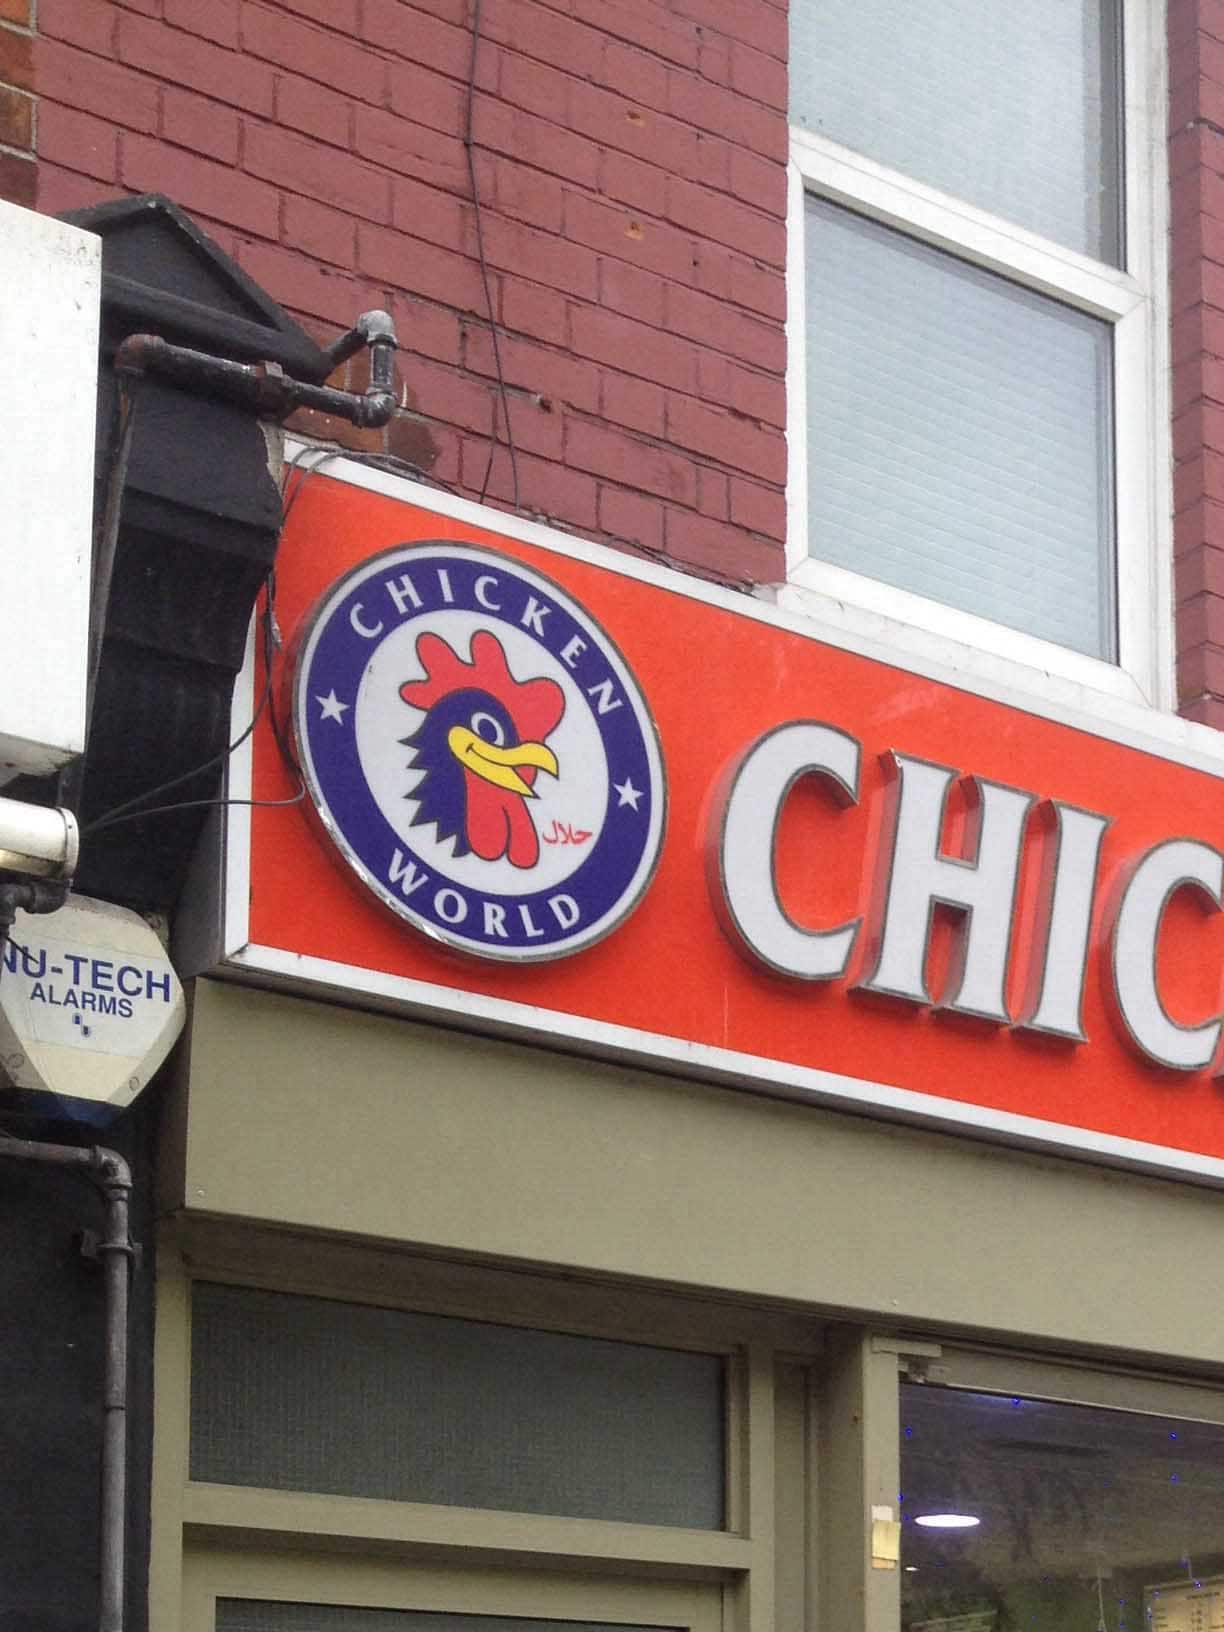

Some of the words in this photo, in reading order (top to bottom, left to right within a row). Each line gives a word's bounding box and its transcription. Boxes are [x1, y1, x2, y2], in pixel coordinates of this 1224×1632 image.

[350, 569, 623, 715] CHICKEN
[386, 848, 582, 938] WORLD
[30, 982, 134, 1018] ALARMS
